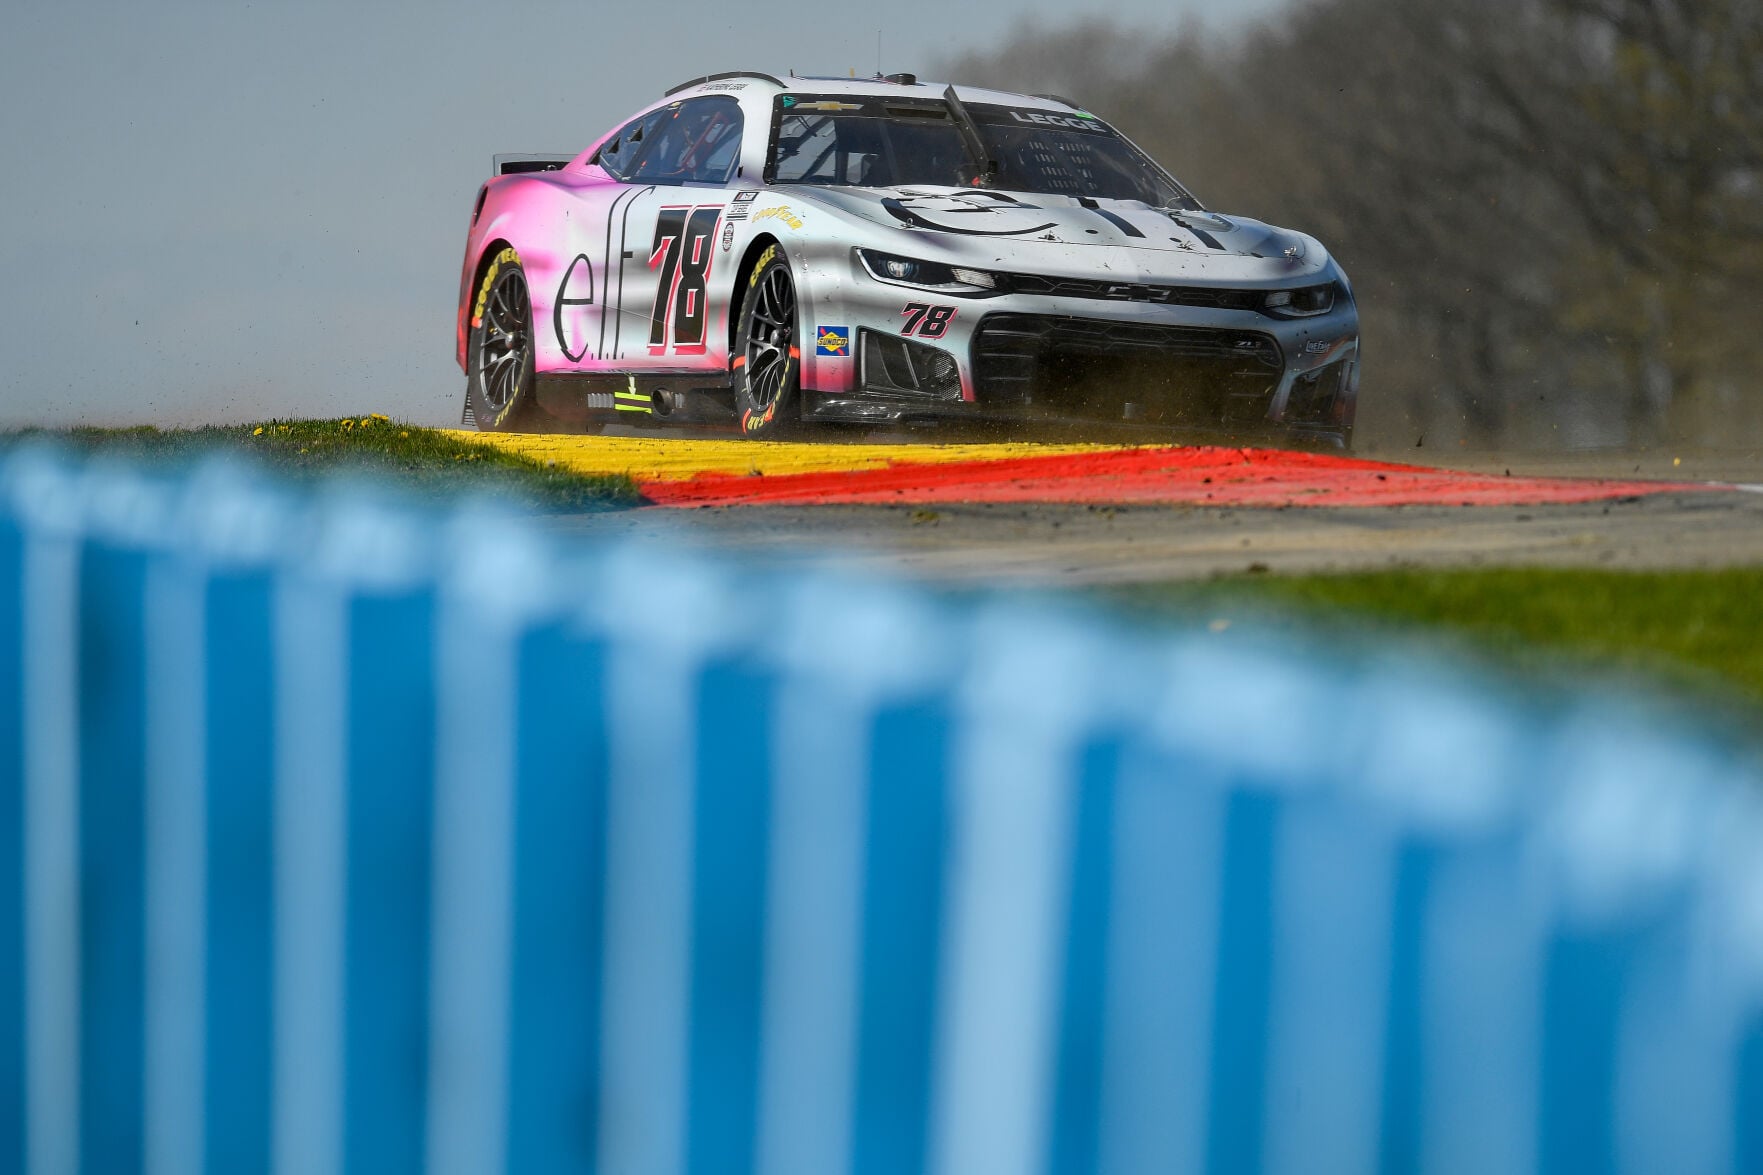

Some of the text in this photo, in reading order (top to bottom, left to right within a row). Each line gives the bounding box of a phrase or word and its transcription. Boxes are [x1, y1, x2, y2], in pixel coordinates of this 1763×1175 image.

[1009, 111, 1107, 132] LEGGE
[647, 204, 726, 356] 78
[749, 244, 776, 289] EAGLE
[900, 301, 959, 340] 78
[817, 337, 848, 347] SUNOCO
